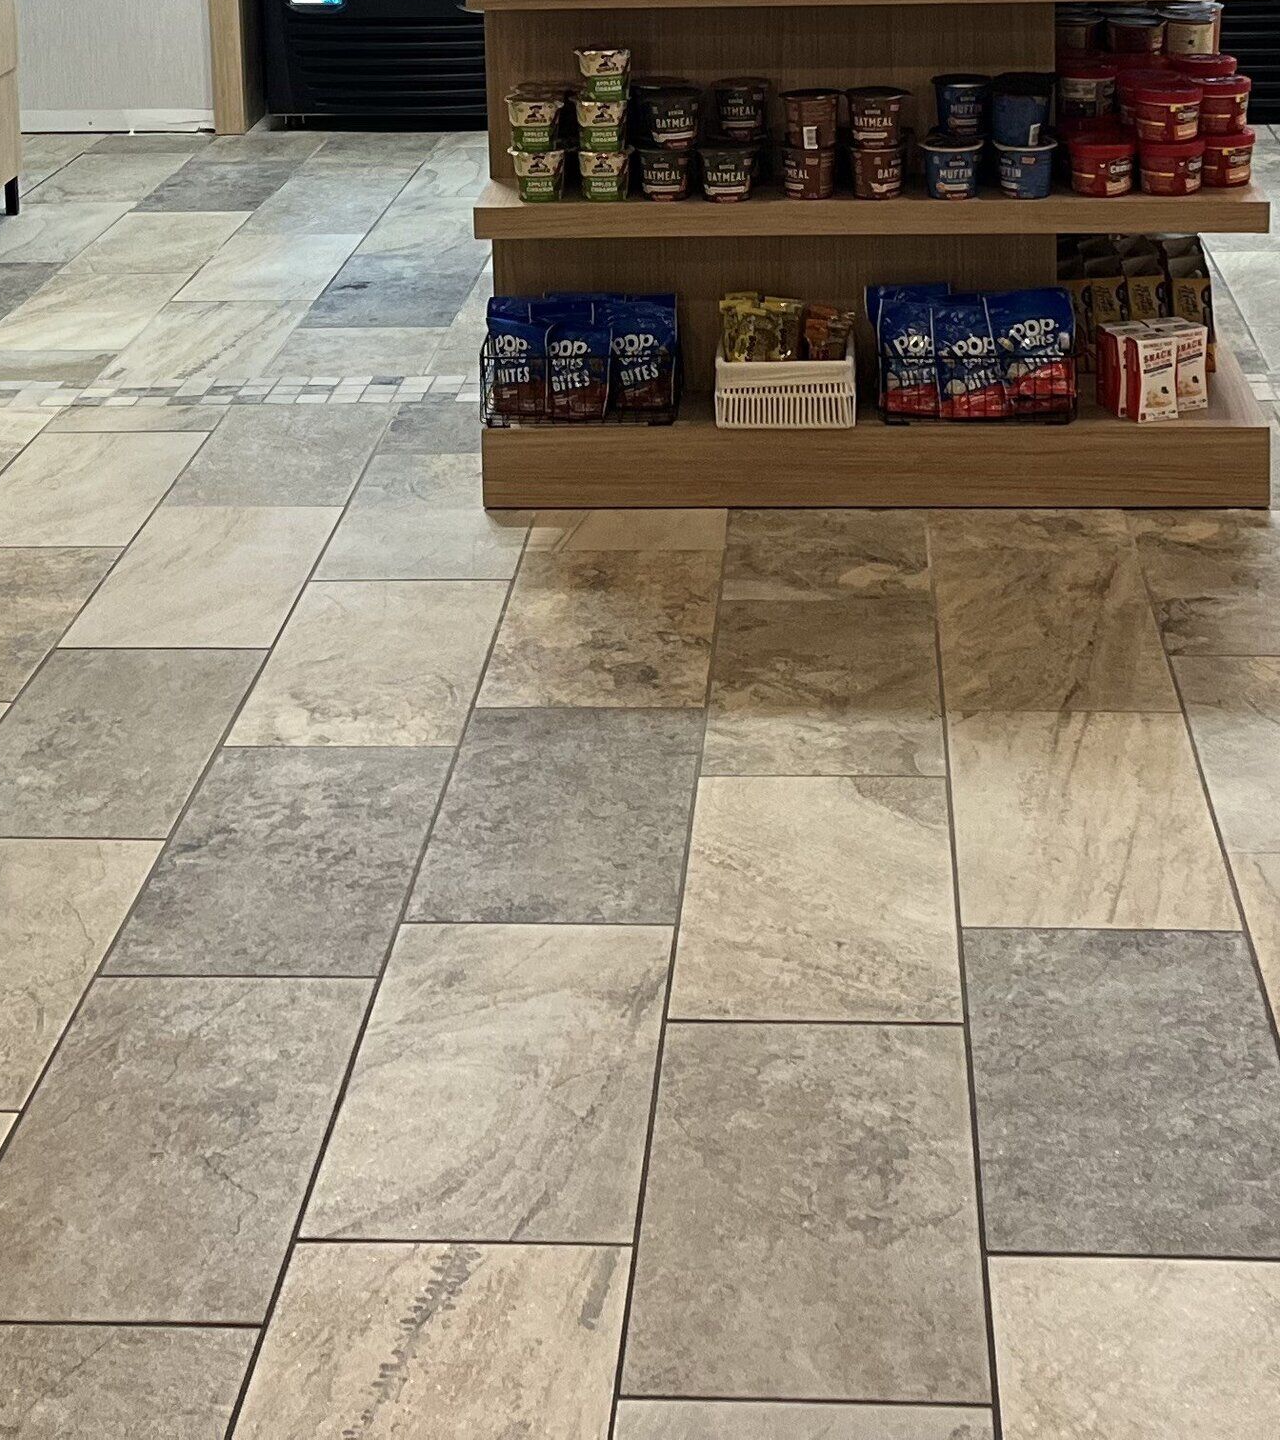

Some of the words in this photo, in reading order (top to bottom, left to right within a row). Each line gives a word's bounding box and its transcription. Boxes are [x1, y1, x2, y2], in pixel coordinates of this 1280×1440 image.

[706, 171, 746, 182] OATMEAL
[787, 169, 809, 179] MEAL
[939, 168, 973, 179] MUFFIN
